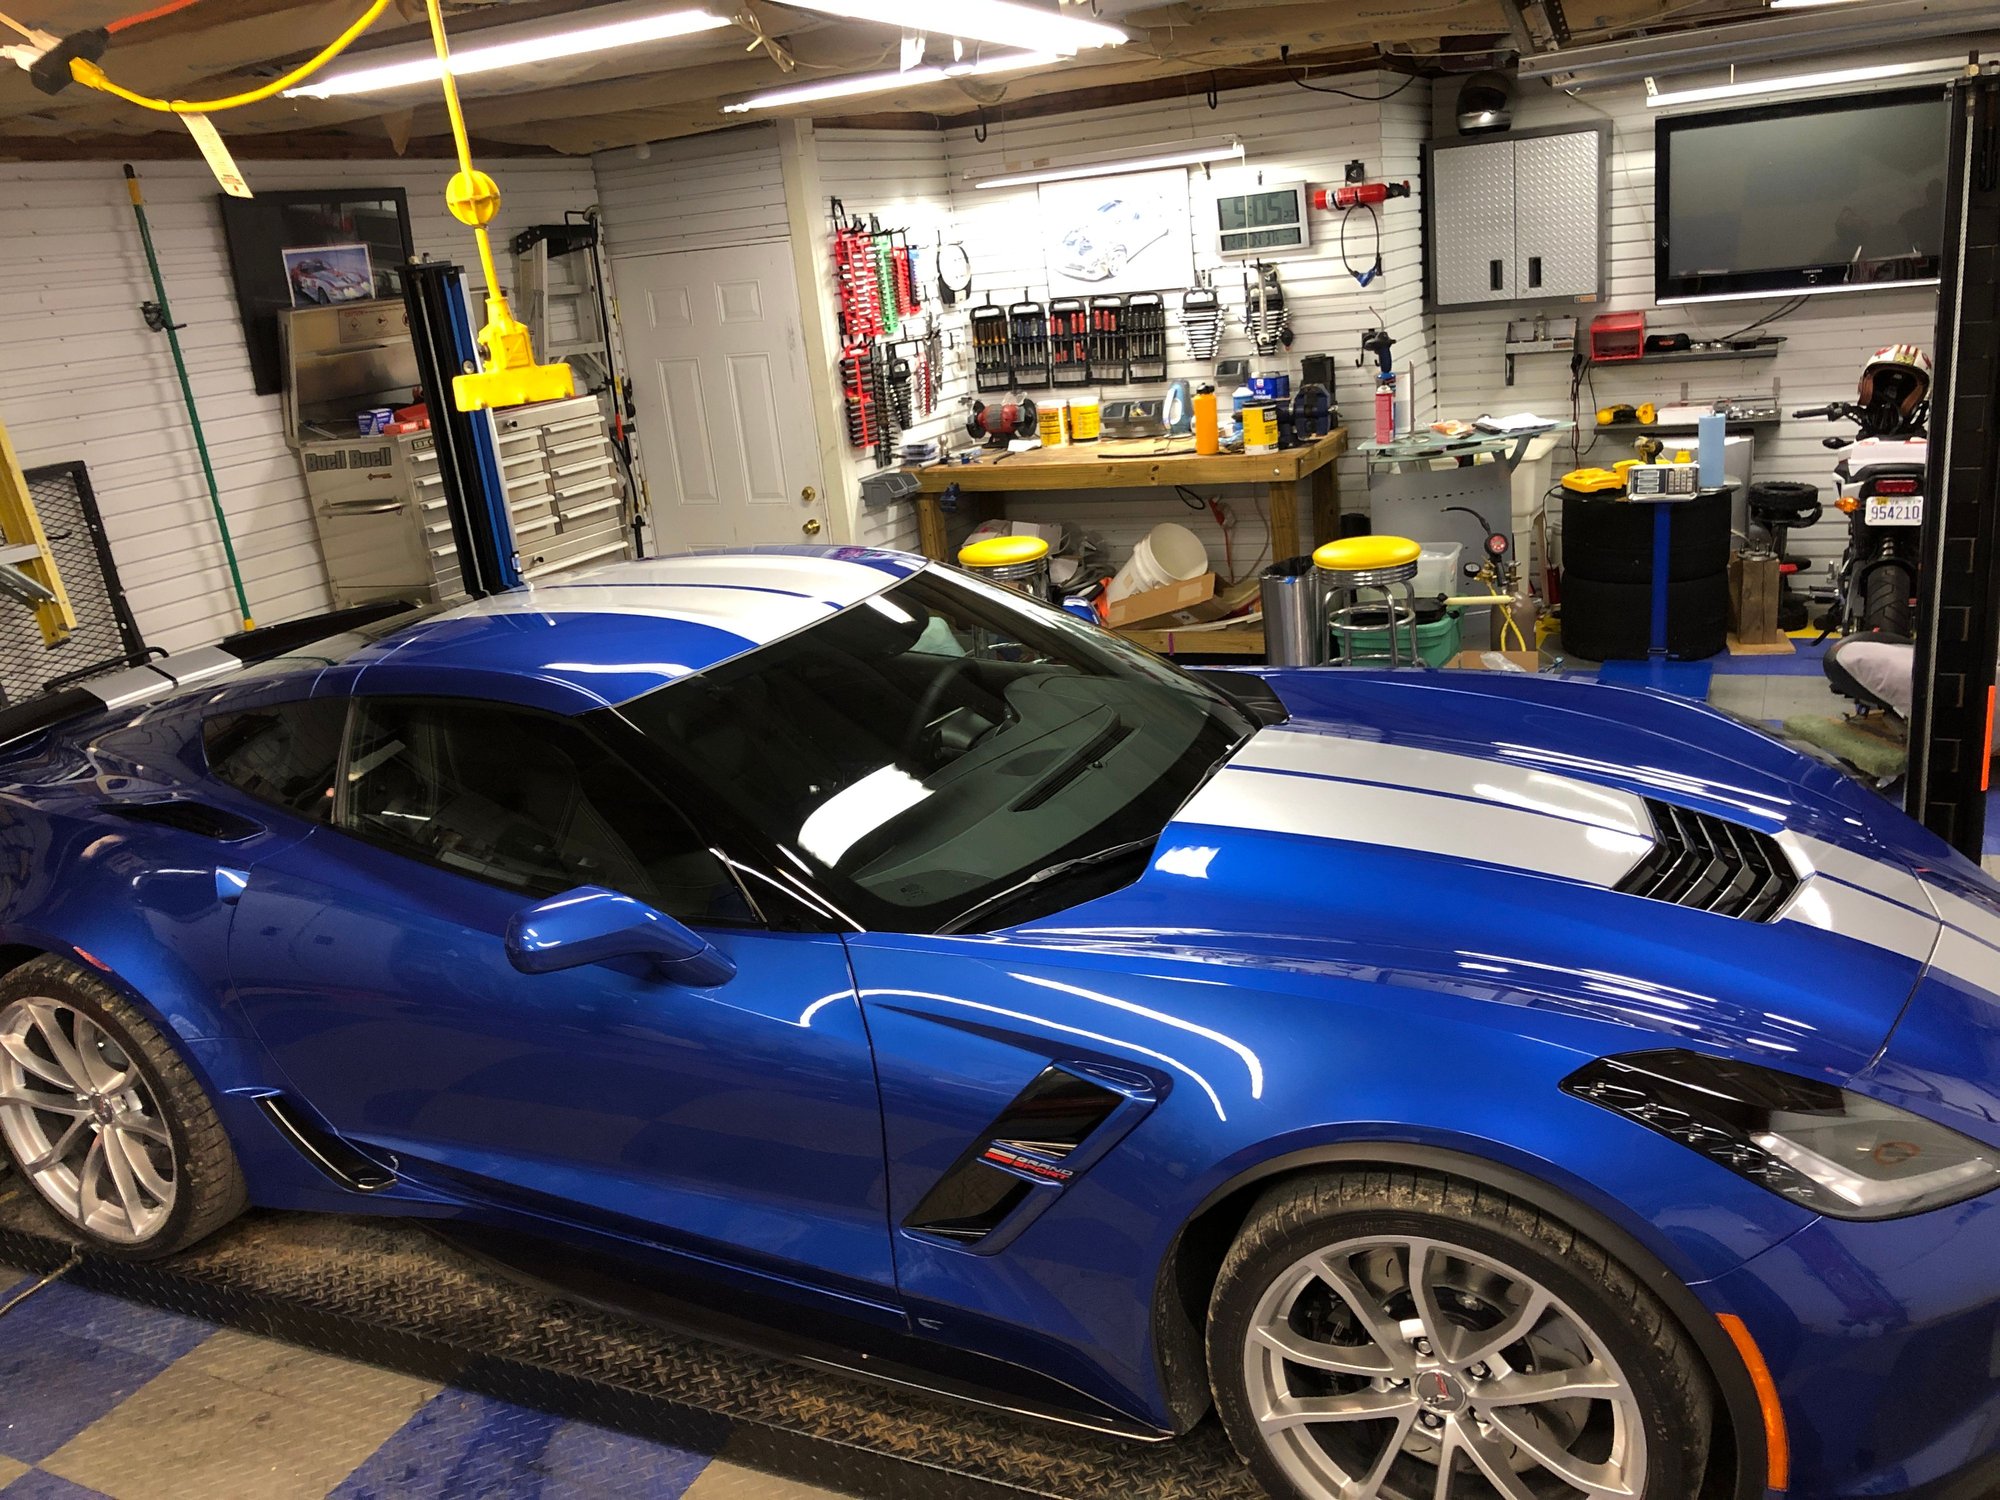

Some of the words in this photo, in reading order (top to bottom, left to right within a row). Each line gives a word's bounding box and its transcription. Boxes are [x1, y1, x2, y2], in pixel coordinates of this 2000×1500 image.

[305, 450, 347, 472] Buell
[348, 447, 392, 469] Buell
[1871, 505, 1920, 520] 954210
[1013, 1160, 1070, 1179] SPORT
[1016, 1156, 1073, 1176] GRAND
